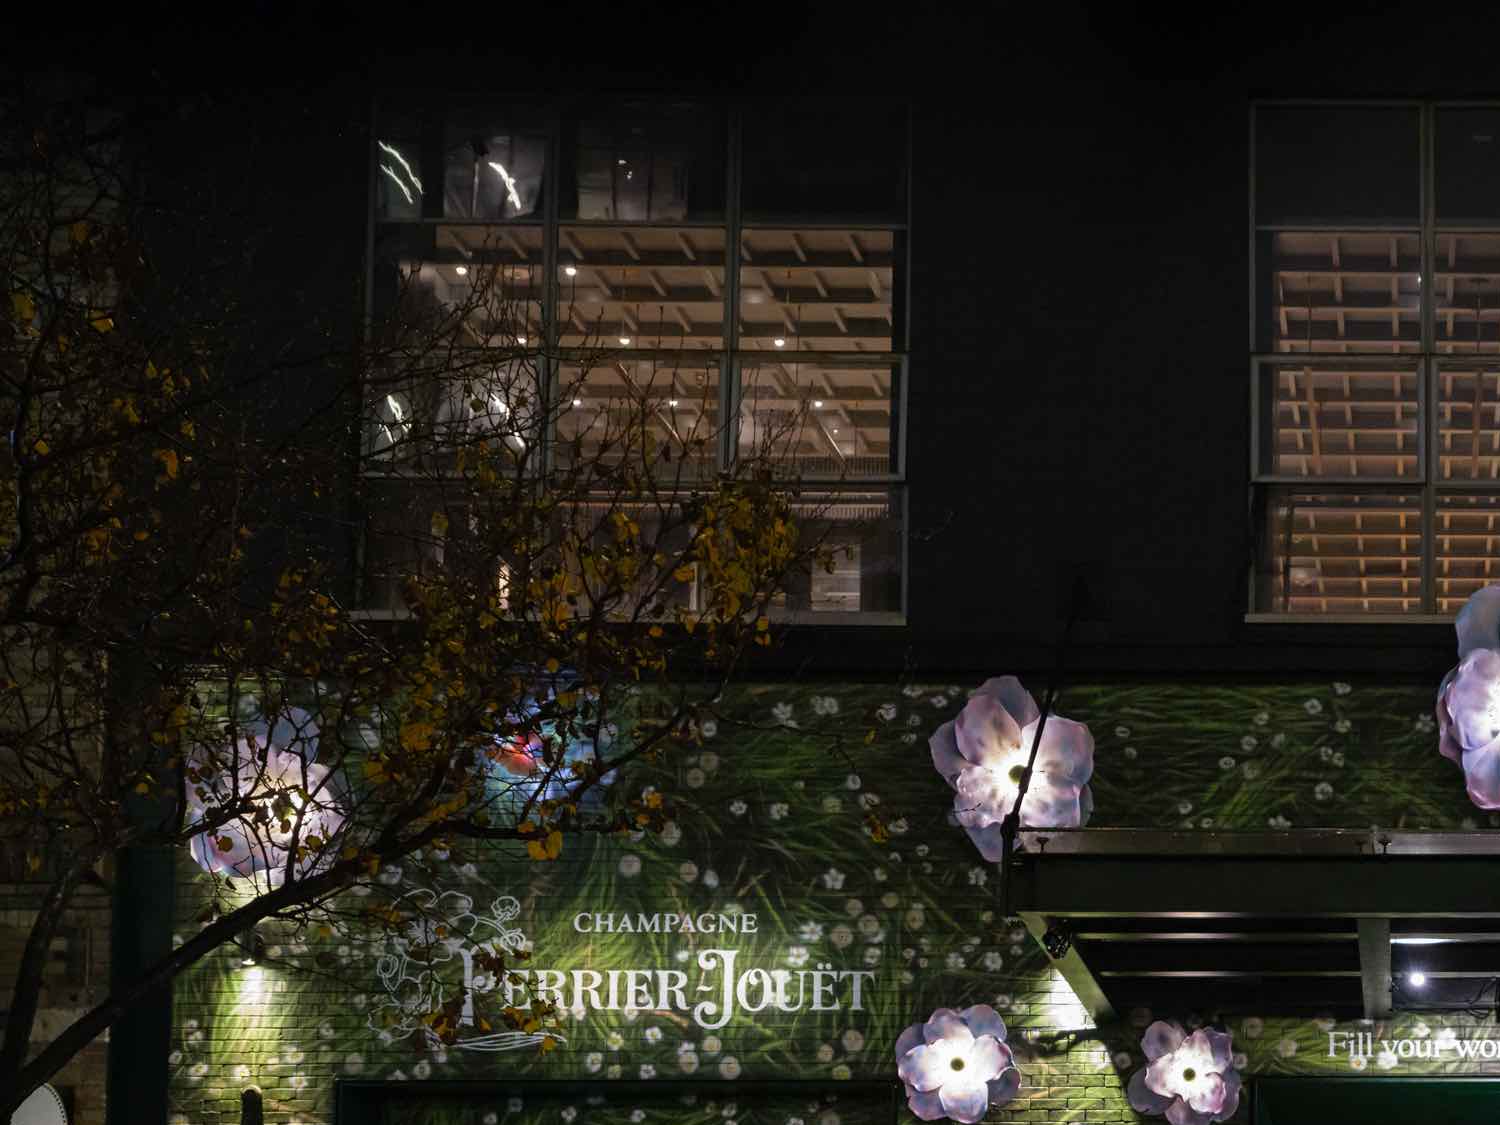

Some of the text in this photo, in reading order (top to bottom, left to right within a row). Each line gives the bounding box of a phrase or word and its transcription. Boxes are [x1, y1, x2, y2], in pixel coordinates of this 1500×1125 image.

[574, 912, 758, 934] CHAMPAGNE
[1326, 1031, 1373, 1058] Fill
[1381, 1037, 1444, 1066] your
